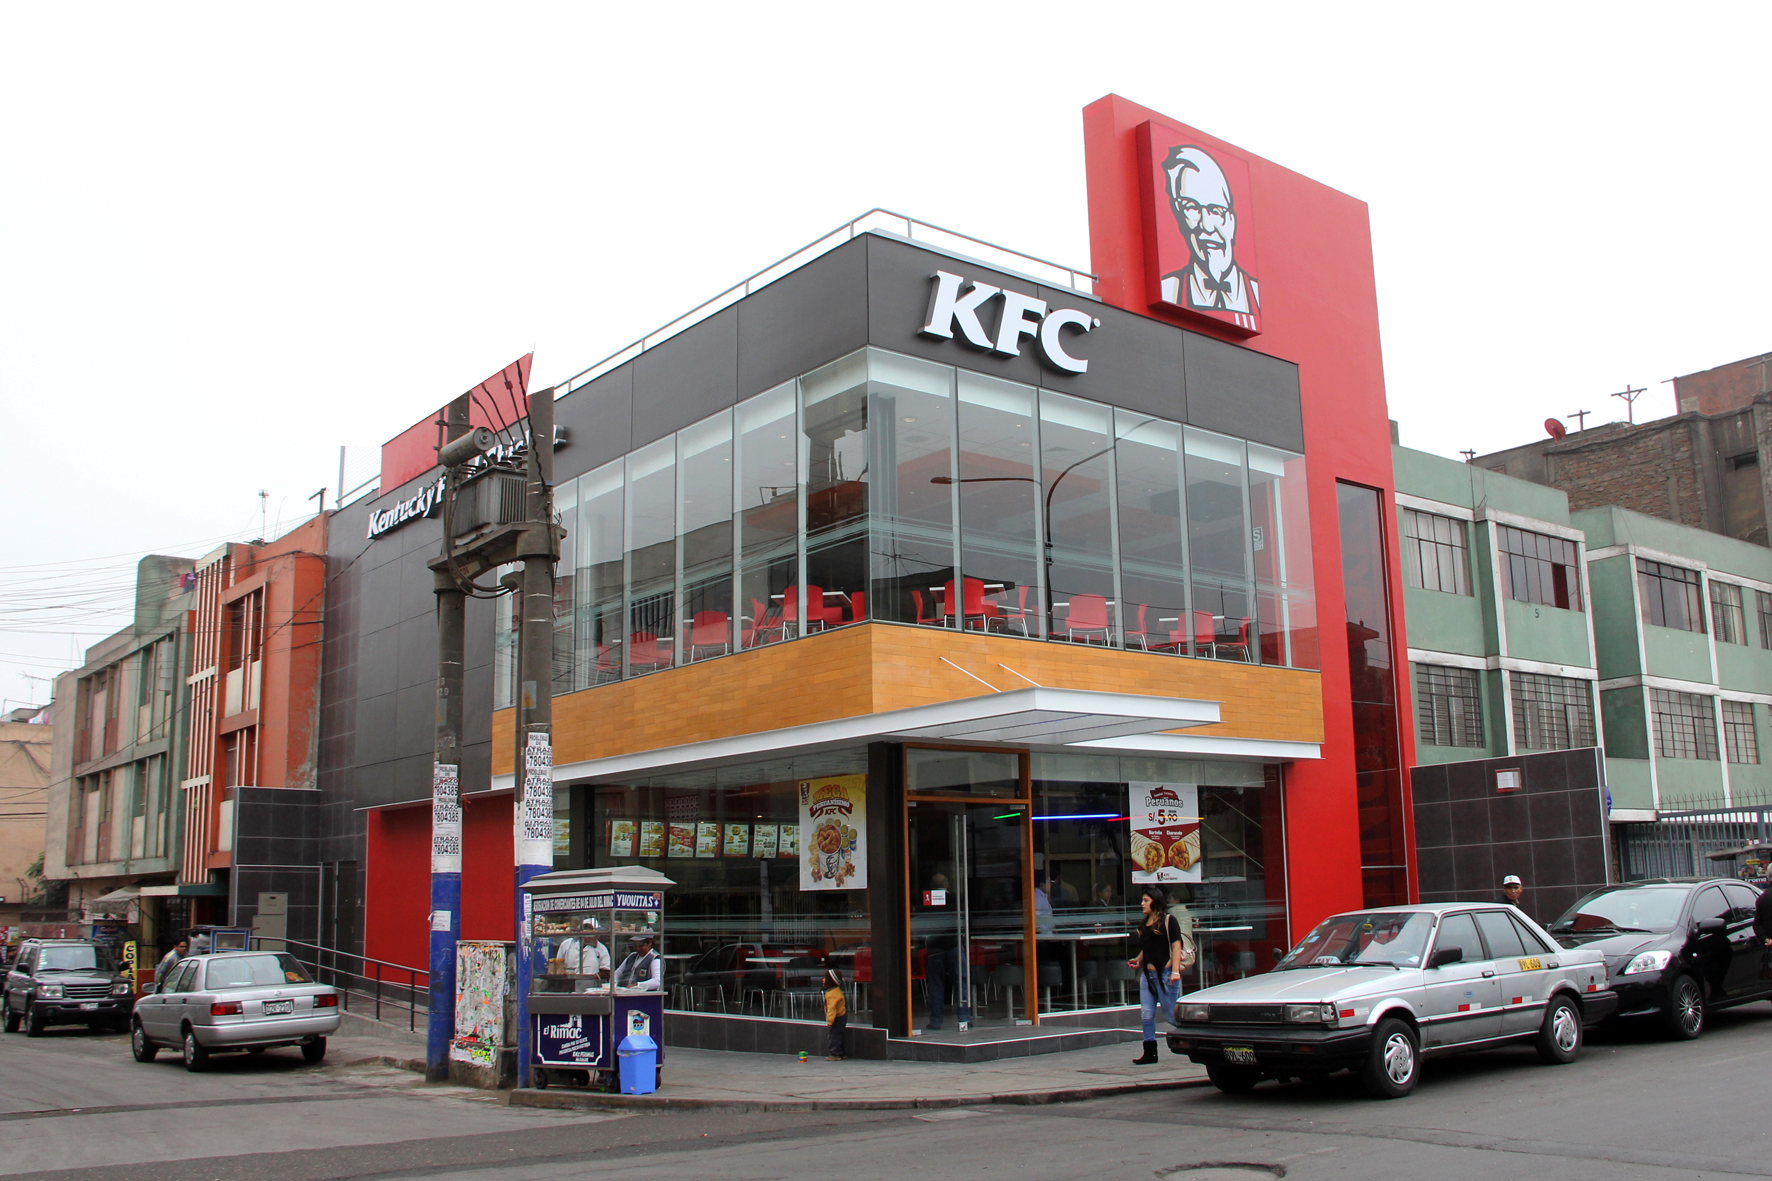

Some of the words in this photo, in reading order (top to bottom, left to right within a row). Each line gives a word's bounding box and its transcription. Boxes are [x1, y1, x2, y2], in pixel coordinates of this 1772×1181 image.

[918, 270, 1092, 374] KFC
[367, 485, 436, 539] Kentucky
[1145, 796, 1183, 808] Peruanos
[824, 808, 837, 816] KFC
[616, 894, 653, 907] YUQUITAS
